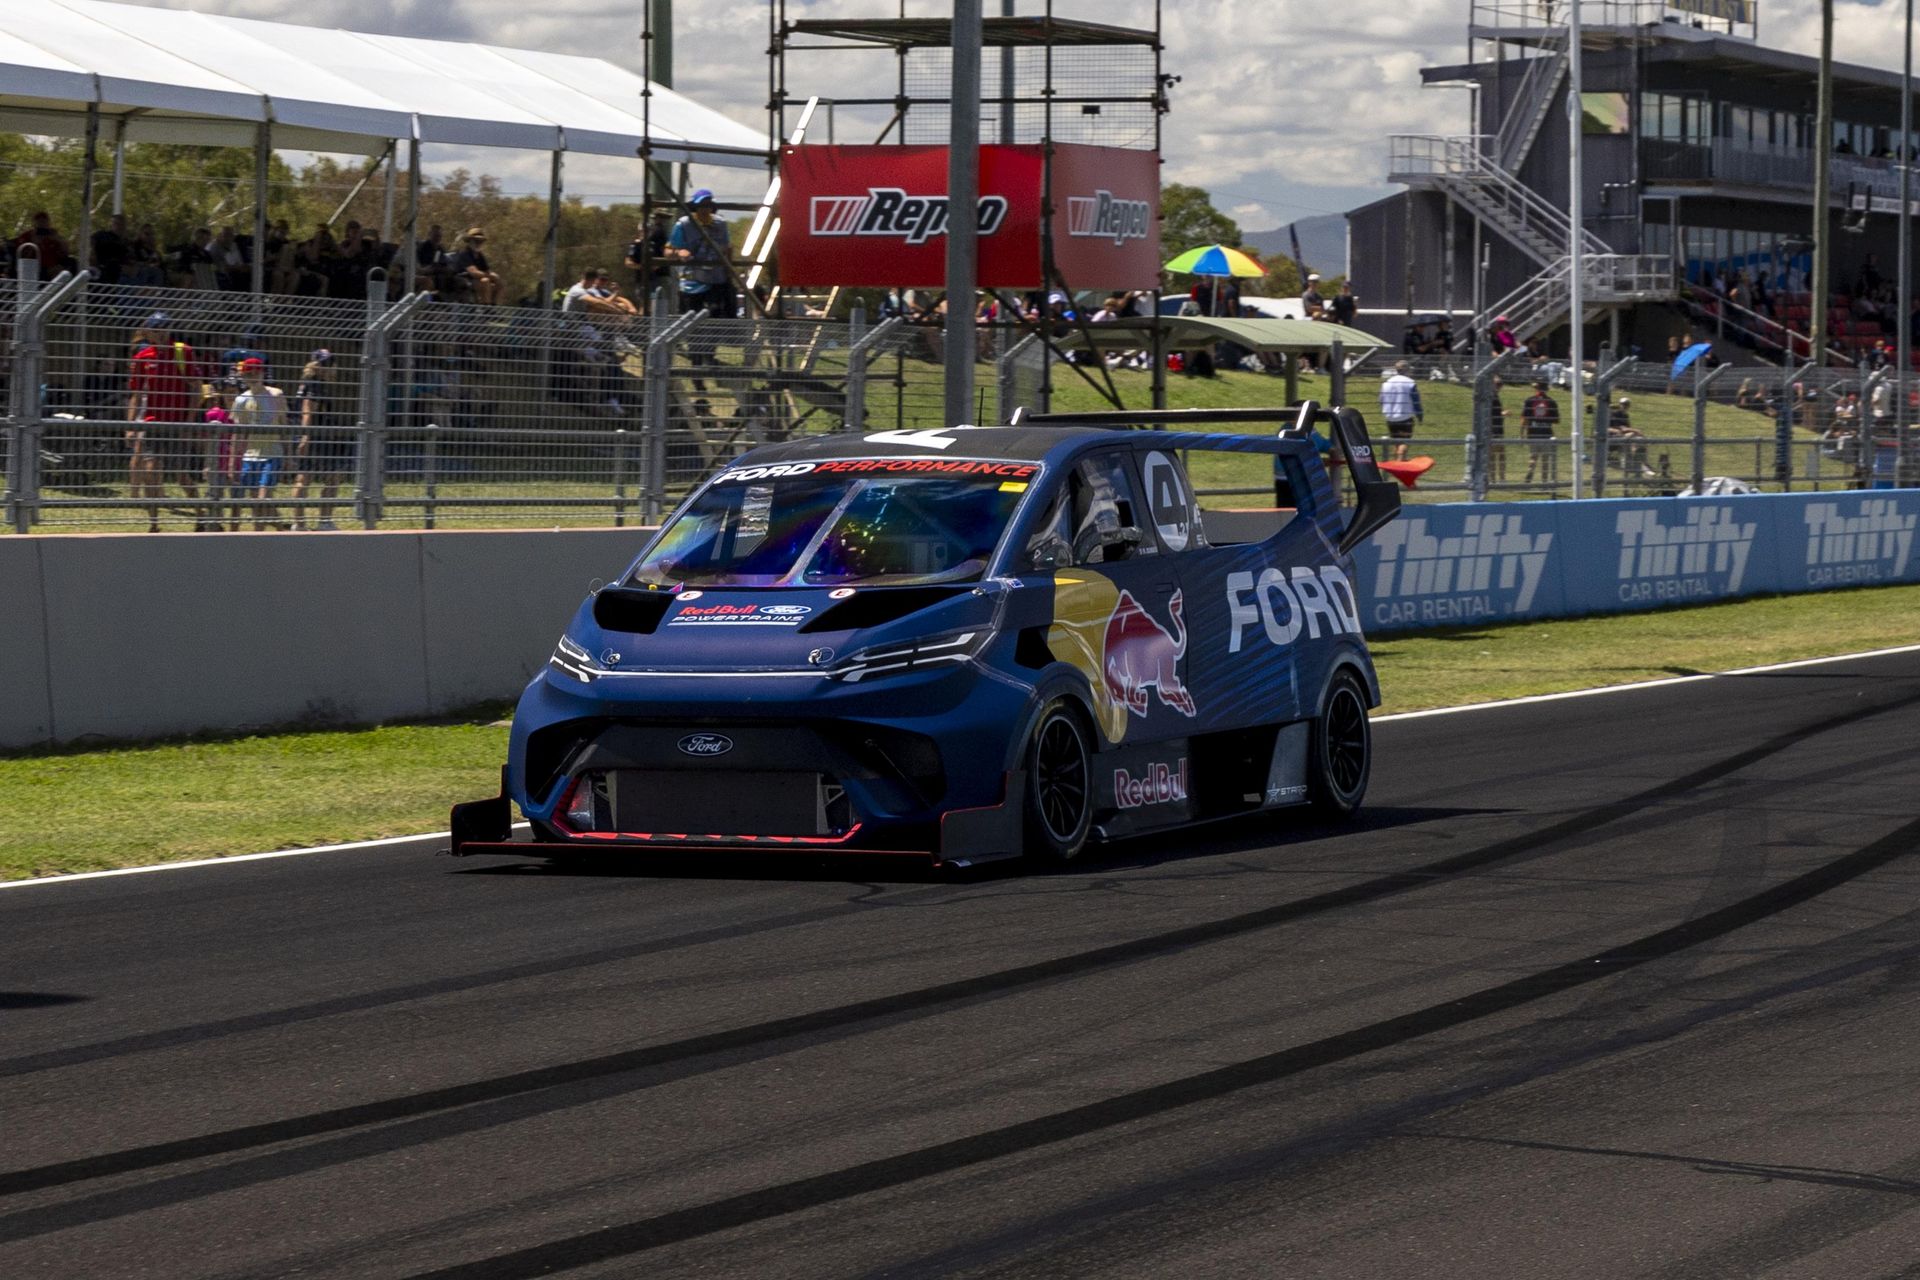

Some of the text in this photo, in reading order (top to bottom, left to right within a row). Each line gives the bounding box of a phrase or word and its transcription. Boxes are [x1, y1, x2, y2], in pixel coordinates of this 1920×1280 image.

[856, 188, 1008, 243] Repo
[1094, 189, 1150, 246] Repco
[713, 460, 1039, 485] FORD PERFORMANCE
[1372, 513, 1553, 613] Thrifty
[1615, 505, 1758, 593] Thrifty
[1804, 498, 1918, 577] Thrifty
[1618, 577, 1713, 602] CAR RENTAL
[1807, 567, 1833, 585] CAR
[679, 604, 758, 616] Red Bull
[1227, 565, 1362, 653] FORD
[1374, 595, 1497, 625] CAR RENTAL
[687, 735, 723, 752] Ford
[1114, 757, 1187, 809] Red Bull
